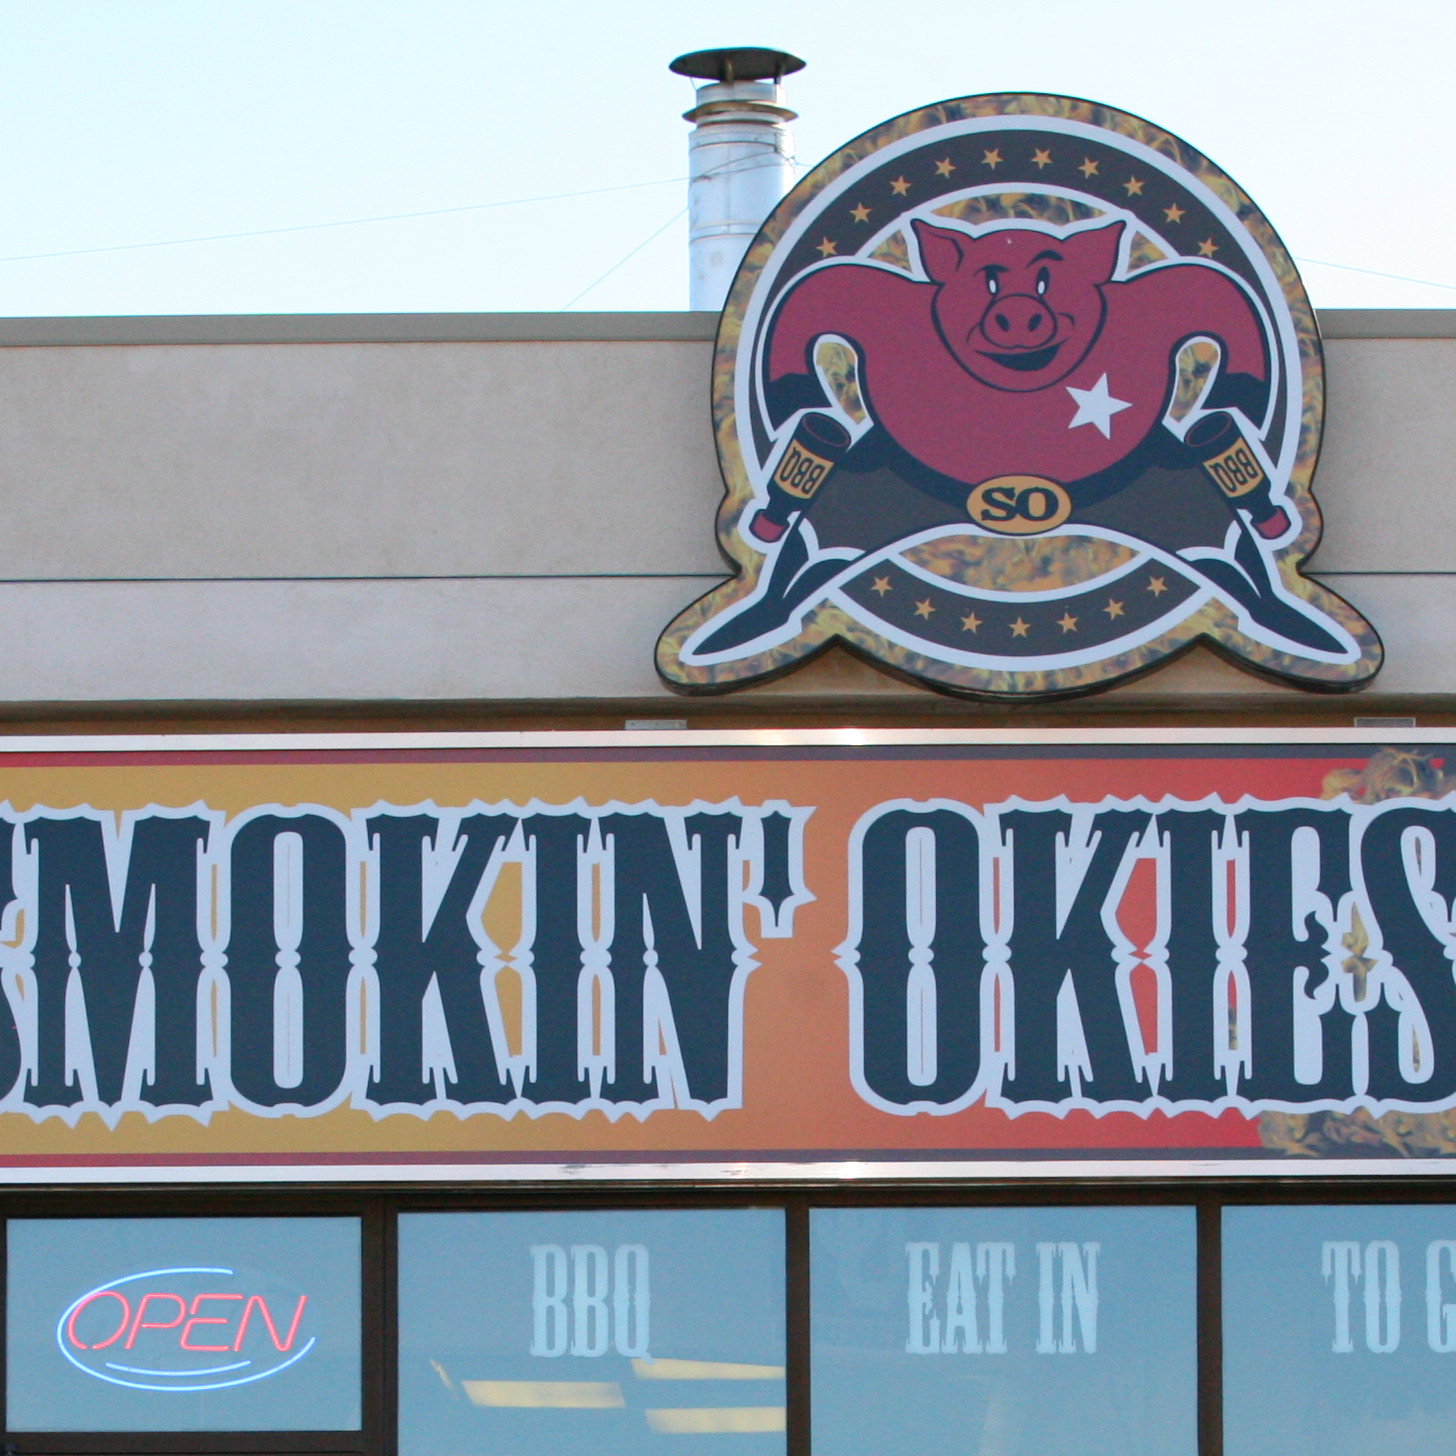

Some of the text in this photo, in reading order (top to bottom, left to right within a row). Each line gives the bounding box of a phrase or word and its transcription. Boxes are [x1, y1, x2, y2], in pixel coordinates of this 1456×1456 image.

[780, 447, 825, 494] BBQ
[1209, 448, 1258, 493] BBQ
[980, 487, 1059, 521] SO
[66, 1291, 308, 1352] OPEN
[529, 1242, 657, 1366] BBQ
[905, 1240, 1101, 1355] EAT IN
[1321, 1239, 1402, 1354] TO
